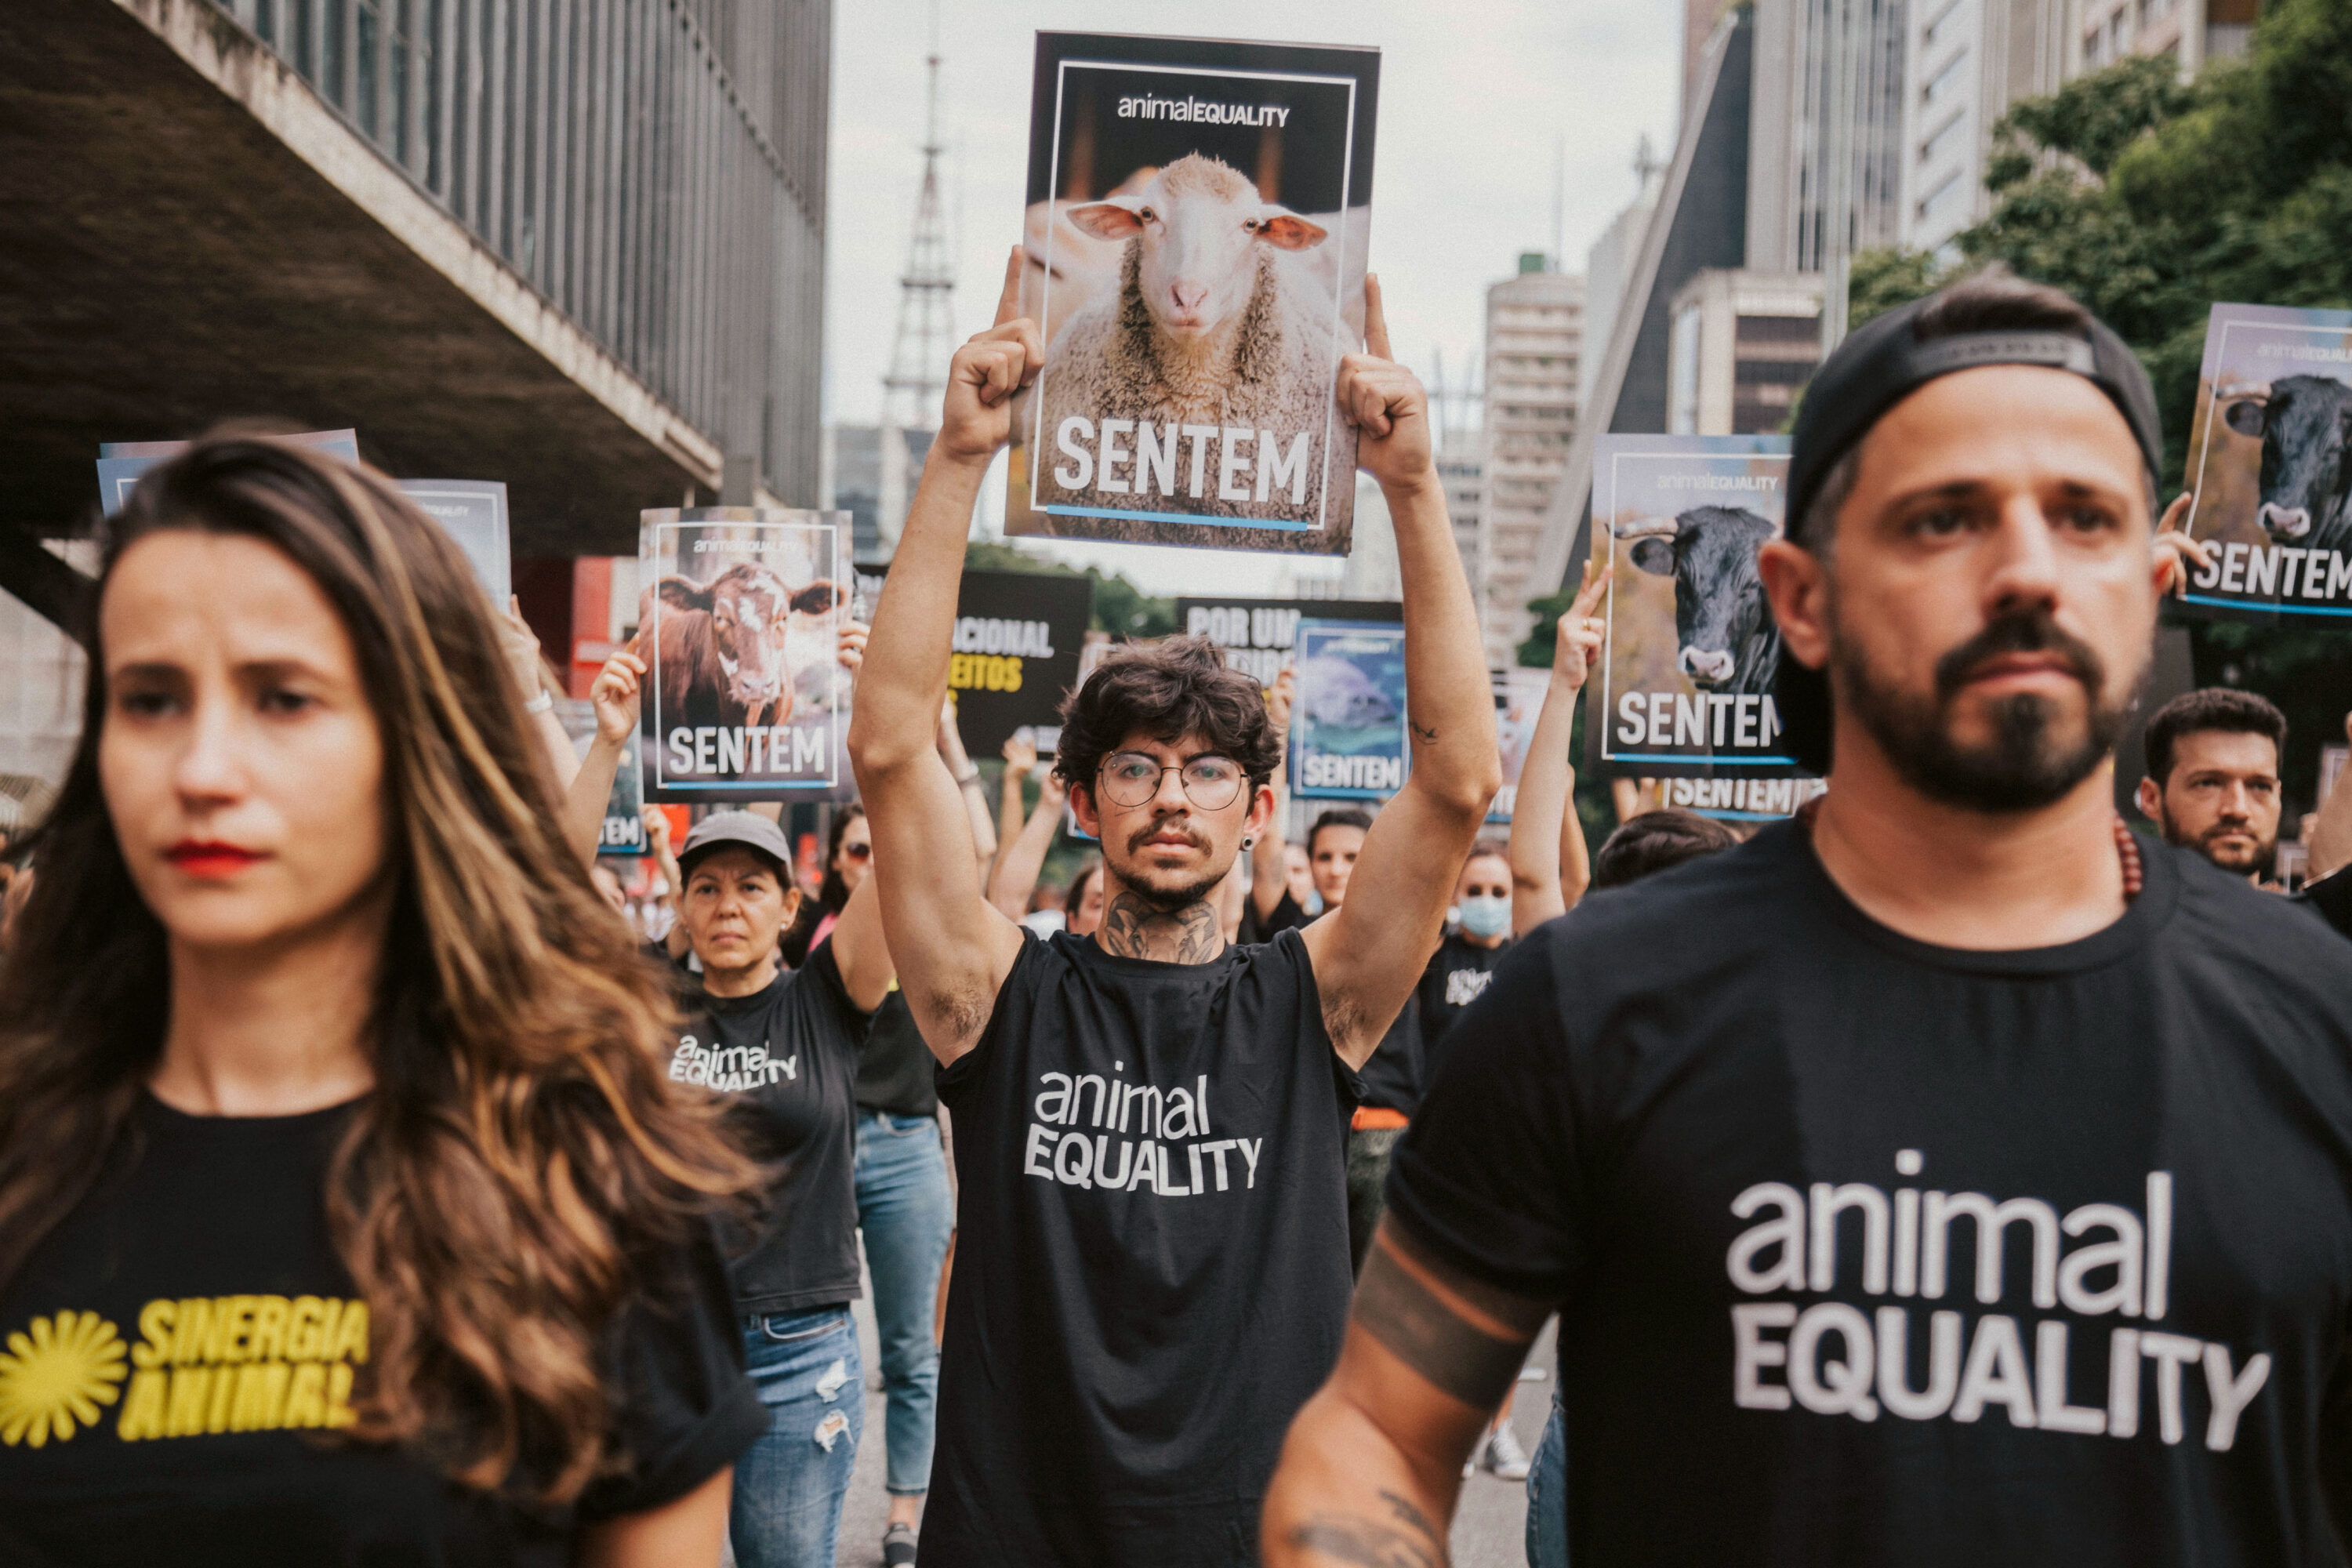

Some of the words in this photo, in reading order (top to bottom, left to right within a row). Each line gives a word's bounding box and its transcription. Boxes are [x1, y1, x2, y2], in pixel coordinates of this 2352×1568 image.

[1117, 93, 1290, 127] animalEQUALITY
[1054, 416, 1310, 505] SENTEM
[2194, 539, 2352, 600] SENTEM
[669, 726, 826, 774] SENTEM
[1302, 753, 1401, 789] SENTEM
[1673, 778, 1791, 813] SENTEM
[669, 1054, 797, 1092] EQUALITY
[1034, 1060, 1210, 1140] animal
[1024, 1123, 1262, 1196] EQUALITY
[1726, 1149, 2172, 1320] animal
[131, 1294, 369, 1367] SINERGIA
[117, 1362, 358, 1441] ANIMAL
[1730, 1301, 2271, 1451] EQUALITY
